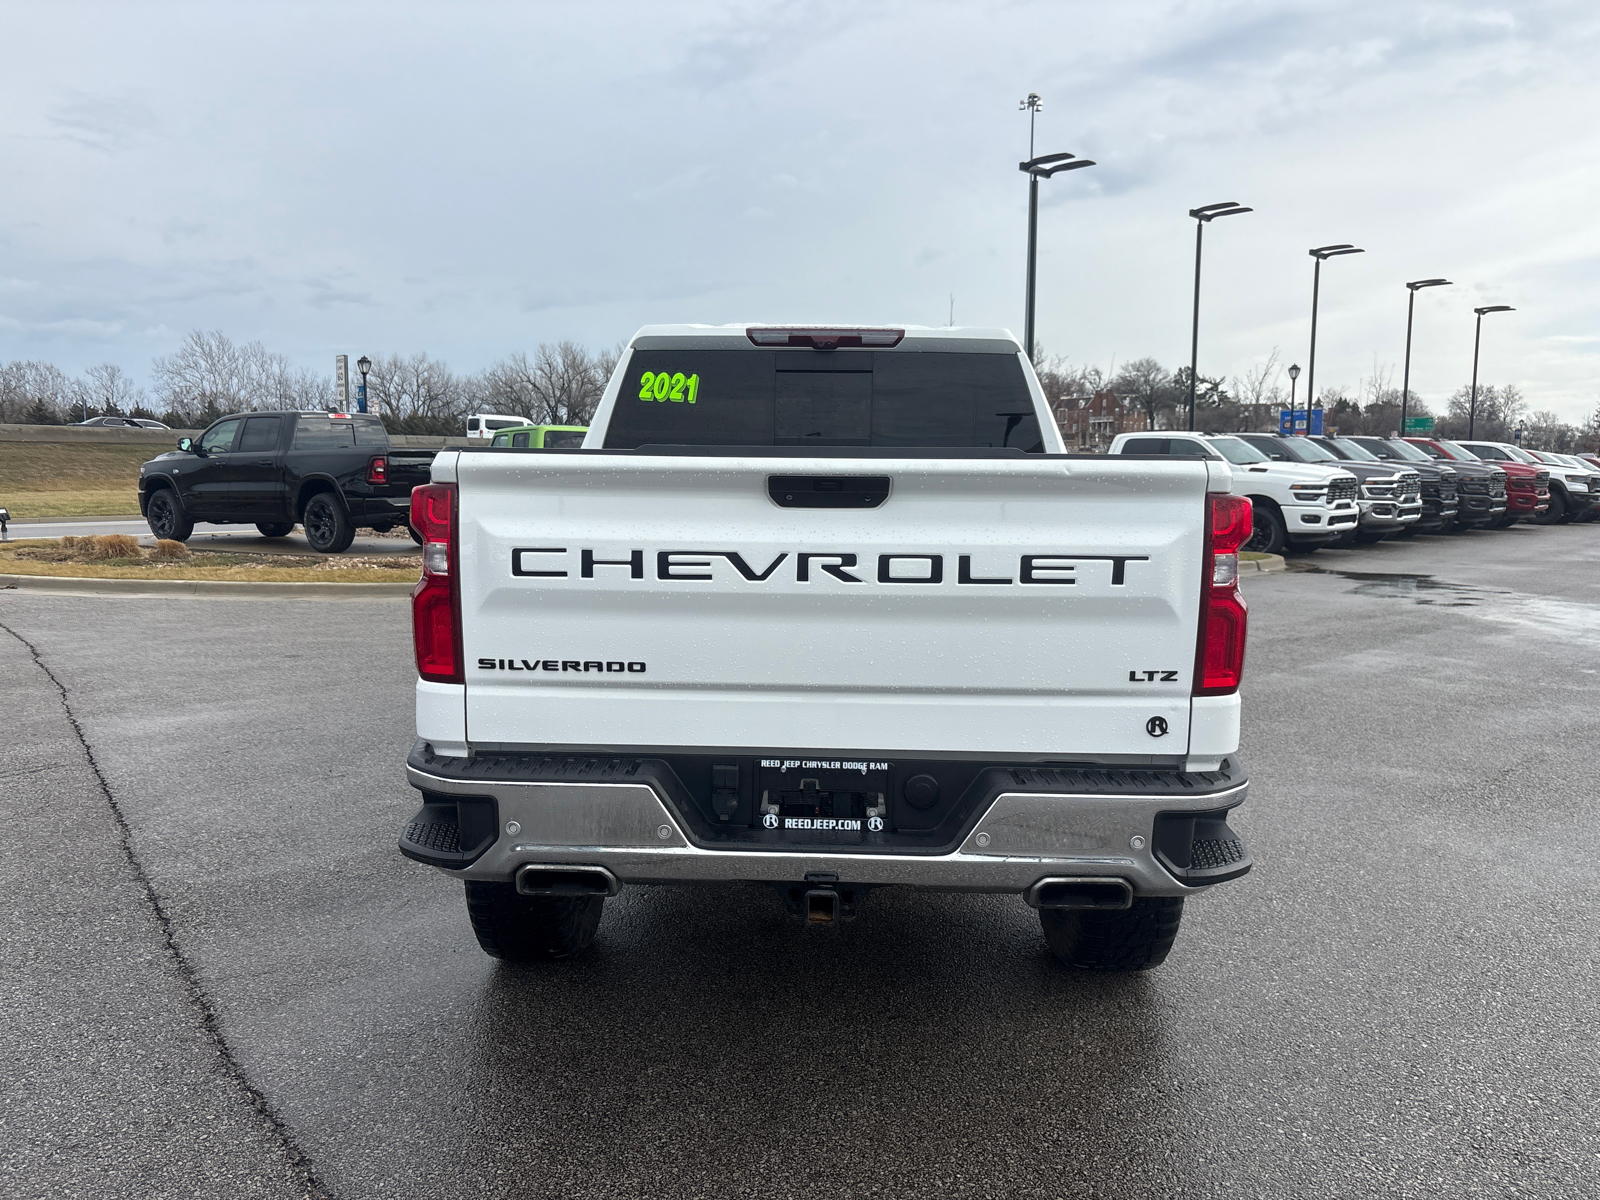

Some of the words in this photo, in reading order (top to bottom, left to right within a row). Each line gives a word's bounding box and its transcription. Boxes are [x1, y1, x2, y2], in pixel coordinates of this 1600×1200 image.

[638, 371, 700, 404] 2021
[511, 547, 1149, 586] CHEVROLET
[478, 658, 646, 673] SILVERADO
[1129, 670, 1178, 682] LTZ
[761, 759, 780, 768] REED
[783, 760, 801, 768] JEEP
[802, 761, 841, 769] CHRYSLER
[842, 762, 868, 770] DODGE
[869, 763, 888, 771] RAM
[785, 818, 861, 831] REEDJEEP.COM
